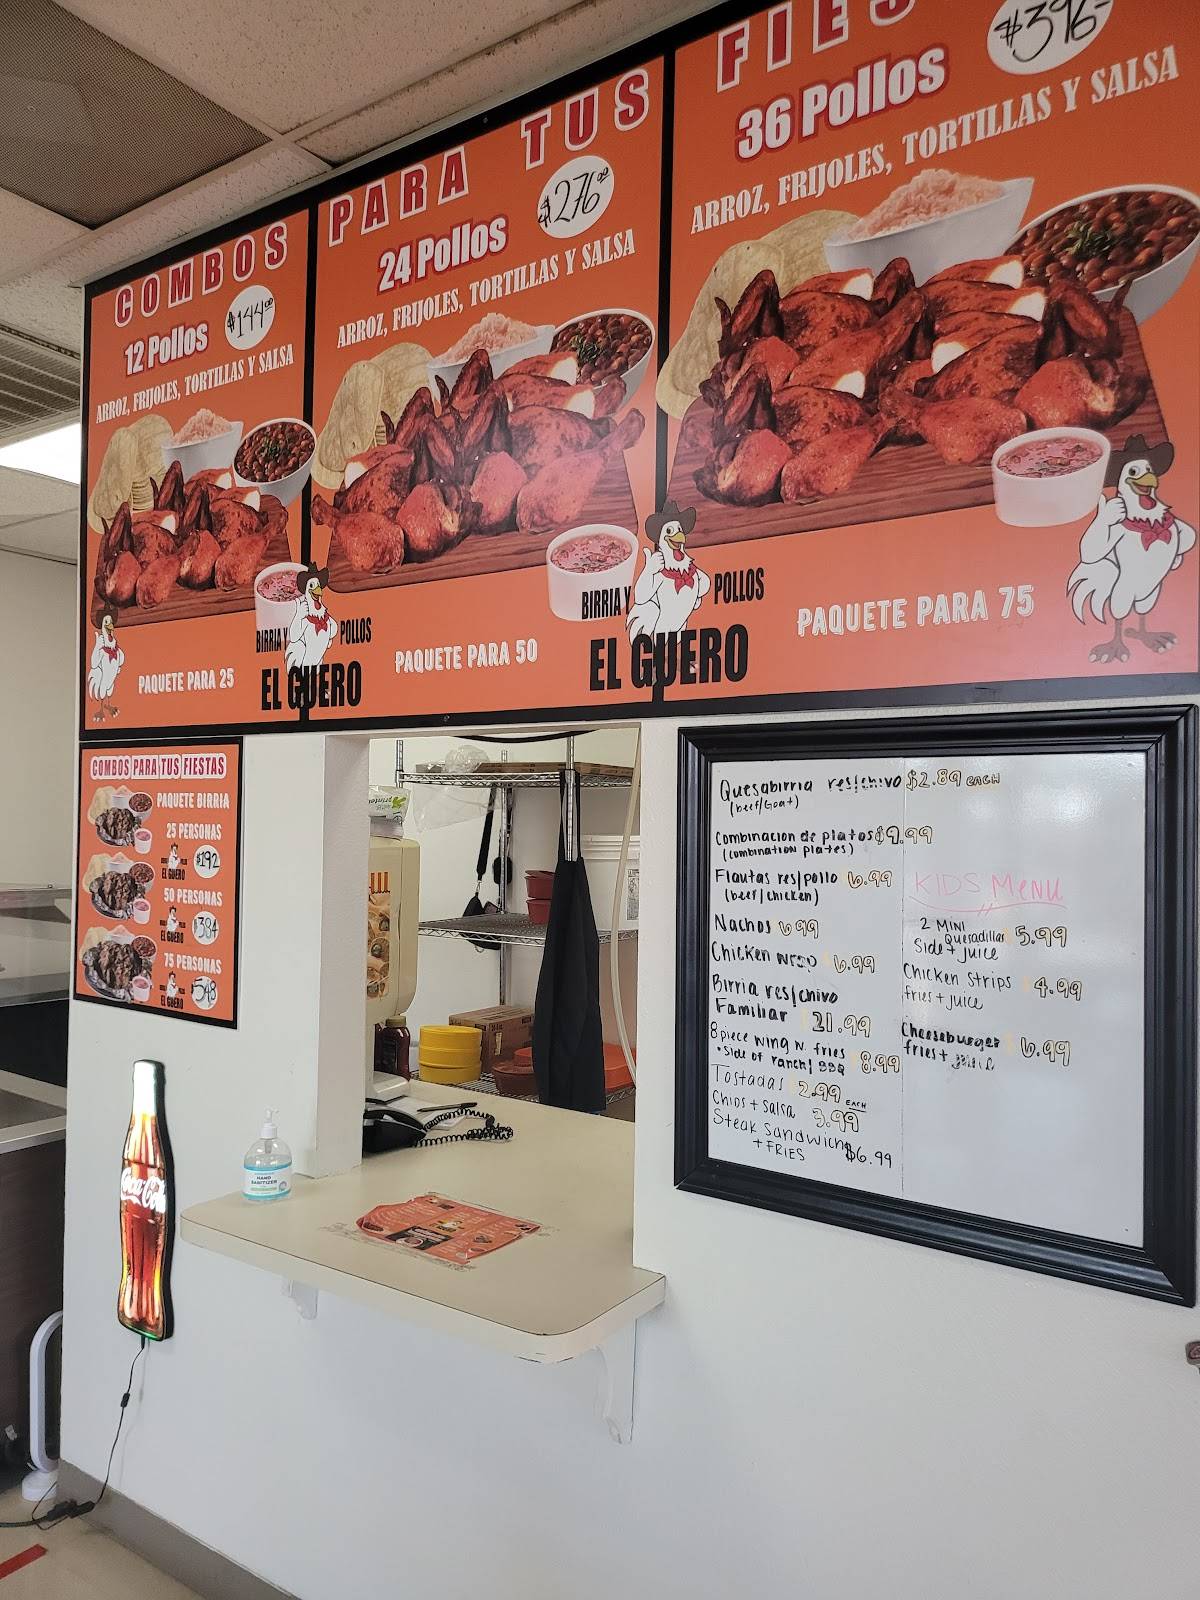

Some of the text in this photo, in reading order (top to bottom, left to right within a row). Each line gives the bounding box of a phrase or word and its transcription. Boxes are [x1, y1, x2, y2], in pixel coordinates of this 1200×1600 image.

[737, 47, 946, 160] 36 Pollos
[690, 44, 1179, 234] ARROZ, FRIJOLES, TORTILLAS Y SALSA
[114, 221, 288, 328] COMBOS
[328, 146, 469, 248] PARA
[521, 68, 649, 171] TUS
[379, 218, 507, 292] 24 Pollos
[336, 229, 636, 349] ARROZ, FRIJOLES, TORTILLAS Y SALSA
[124, 322, 209, 376] 12 Pollos
[95, 343, 294, 423] ARROZ, FRIJOLES, TORTILLAS Y SALSA
[581, 567, 765, 620] BIRRIA Y POLLOS
[796, 584, 1034, 636] PAQUETE PARA 75
[256, 617, 372, 653] BIRRIA Y POLLOS
[395, 637, 538, 674] PAQUETE PARA 50
[589, 623, 749, 691] EL GUERO
[138, 668, 235, 695] PAQUETE PARA 25
[261, 660, 362, 711] EL GUERO
[92, 756, 225, 777] COMBOS PARA TUS FIESTAS
[720, 779, 813, 801] Quesabirria
[906, 768, 962, 791] $2.89
[157, 793, 230, 809] PAQUETE BIRRIA
[166, 823, 222, 840] 25 PERSONAS
[716, 831, 796, 846] Combinacion
[800, 830, 815, 842] de
[161, 867, 167, 880] EL
[715, 868, 770, 884] Flautas
[848, 870, 892, 888] 6.99
[915, 871, 980, 896] KIDS
[163, 887, 223, 907] 50 PERSONAS
[160, 930, 166, 942] EL
[715, 914, 771, 934] Nachos
[920, 917, 965, 933] 2 MINI
[1015, 925, 1067, 948] 5.99
[711, 941, 770, 962] Chicken
[834, 954, 875, 973] 6.99
[914, 937, 943, 955] Side
[163, 953, 222, 975] 75 PERSONAS
[713, 973, 759, 997] Birria
[903, 962, 959, 985] Chicken
[1034, 976, 1082, 1001] 4.99
[904, 985, 932, 1003] fries
[715, 997, 871, 1038] Familiar 21.99
[720, 1028, 748, 1042] piece
[754, 1035, 789, 1055] wing
[813, 1042, 845, 1059] fries
[903, 1039, 936, 1060] fries
[1020, 1036, 1071, 1066] 6.99
[860, 1050, 900, 1074] 8.99
[711, 1063, 842, 1103] Tostadas 2.99
[713, 1108, 757, 1134] Steak
[812, 1107, 859, 1132] 3.99
[767, 1140, 805, 1161] FRIES
